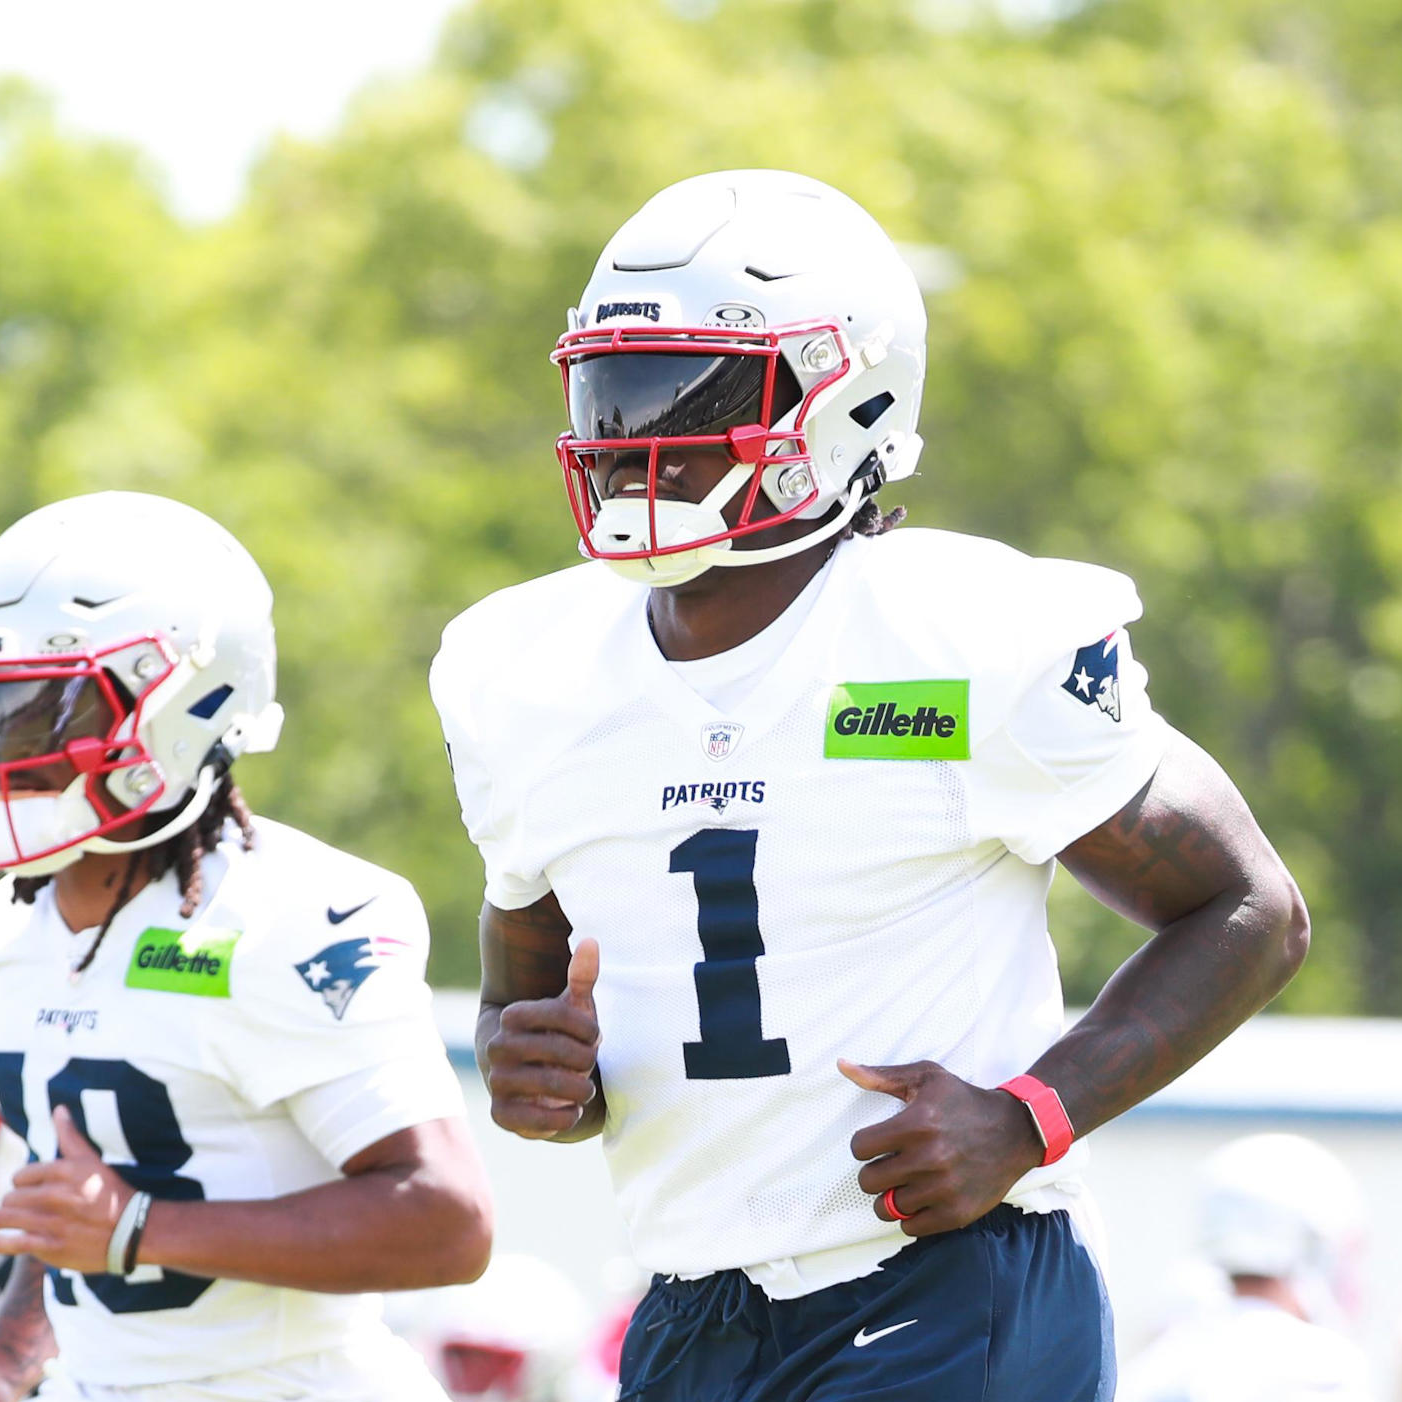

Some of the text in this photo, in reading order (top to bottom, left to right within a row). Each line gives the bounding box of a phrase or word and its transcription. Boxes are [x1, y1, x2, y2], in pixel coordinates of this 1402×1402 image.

[834, 702, 956, 738] Gillette
[710, 741, 729, 754] NFL
[662, 781, 765, 810] PATRIOTS
[138, 944, 220, 976] Gillette
[669, 828, 791, 1079] 1
